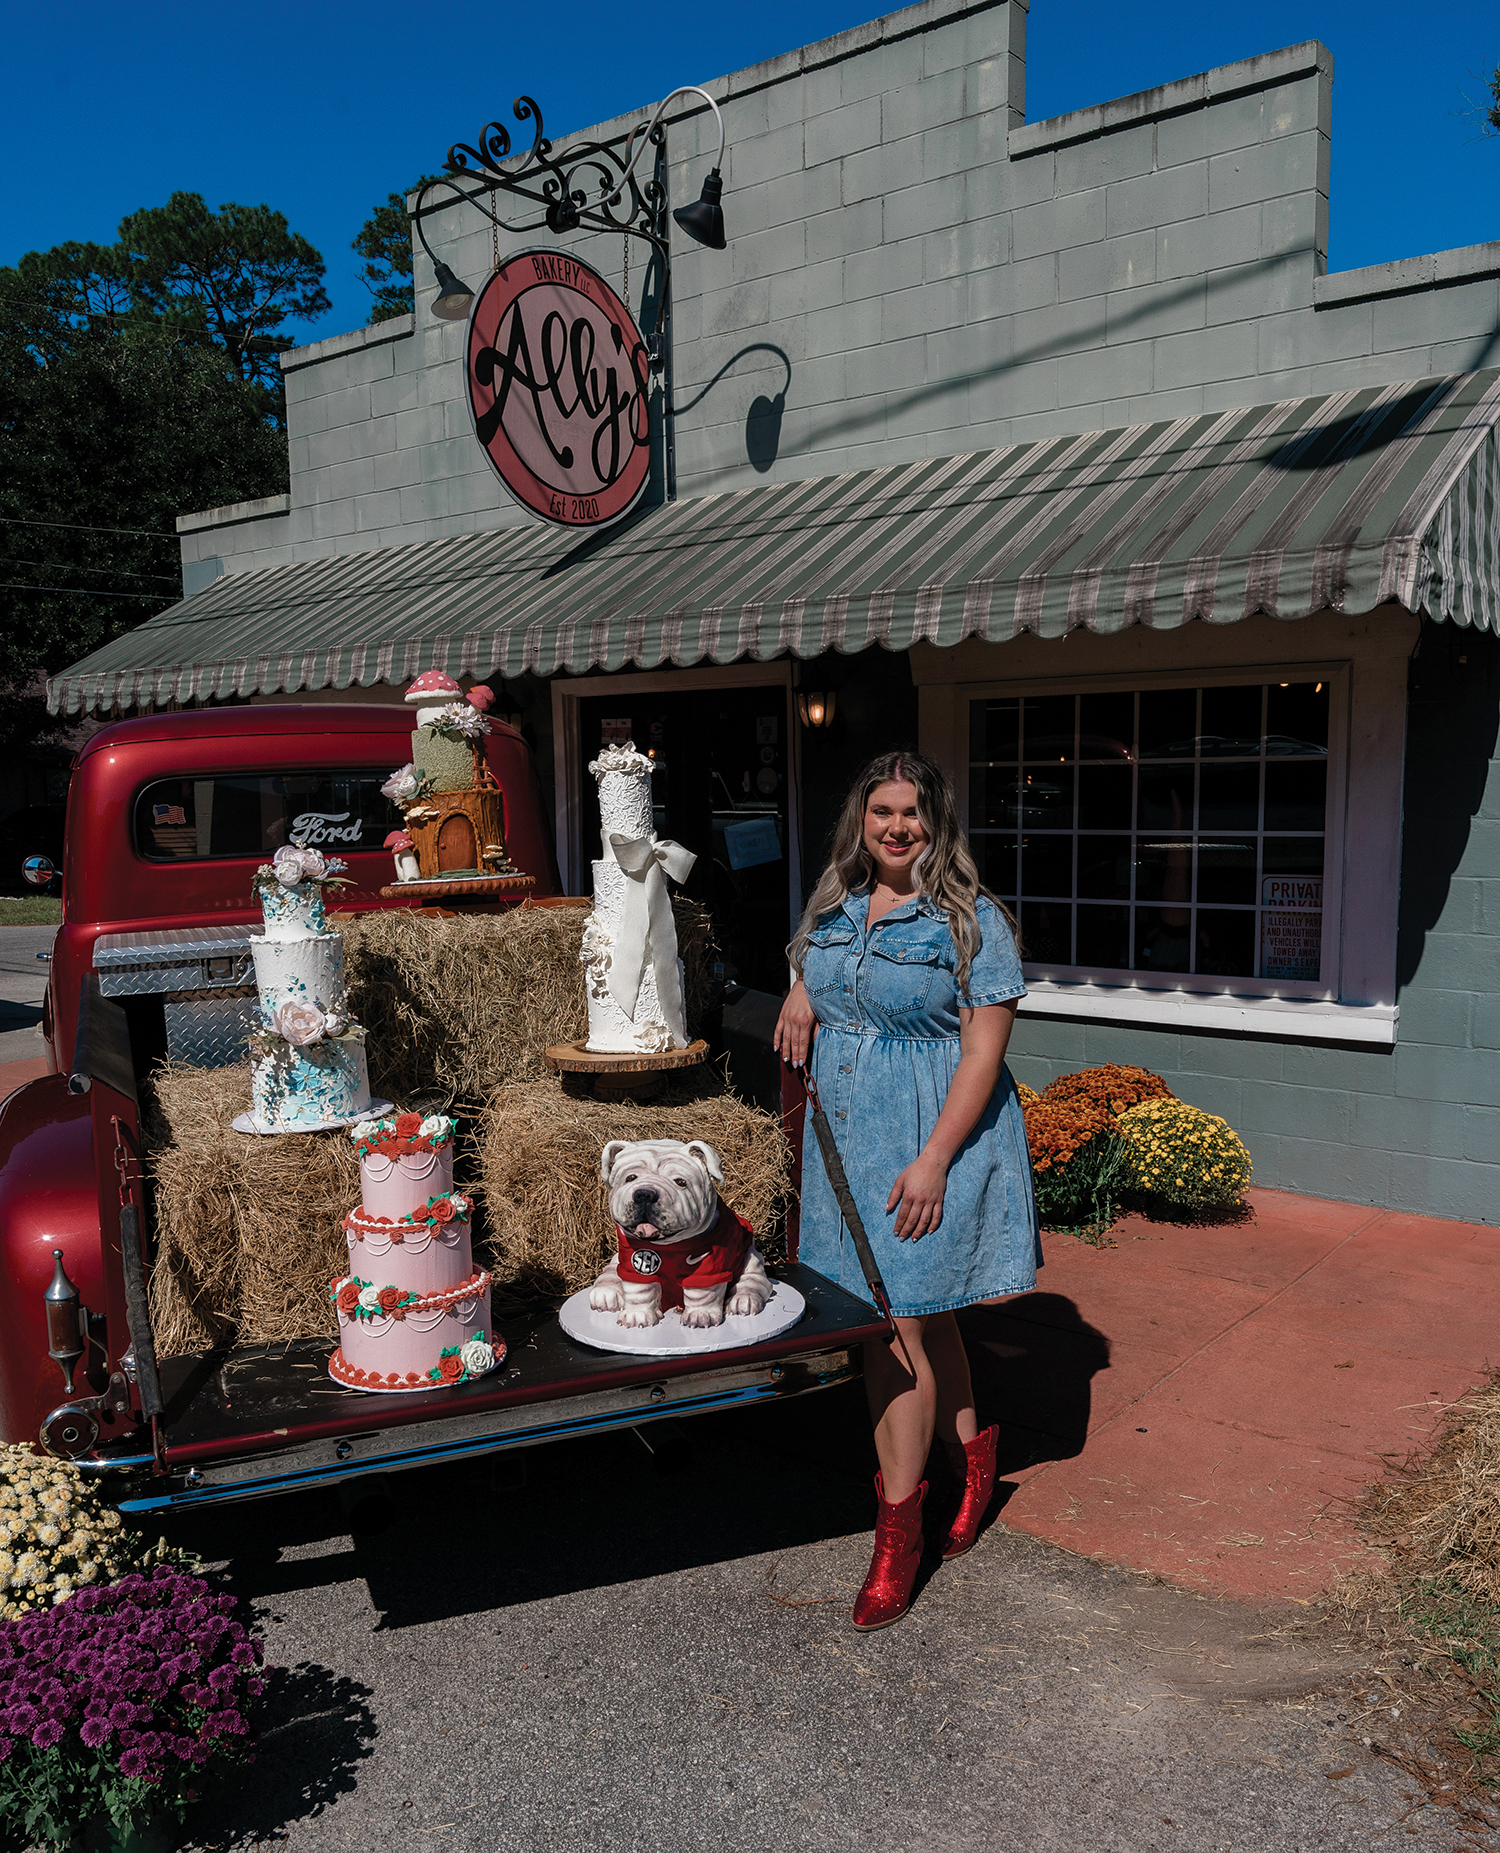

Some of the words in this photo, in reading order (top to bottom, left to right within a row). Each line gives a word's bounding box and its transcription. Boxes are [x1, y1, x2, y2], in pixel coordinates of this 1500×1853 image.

[531, 256, 580, 286] BAKERY
[580, 278, 591, 294] LLC
[475, 299, 650, 484] Ally's
[549, 493, 566, 518] Est
[571, 498, 600, 519] 2020
[289, 812, 363, 844] Ford
[739, 837, 765, 850] OPEN
[1271, 882, 1322, 899] PRIVAT
[1268, 917, 1303, 926] ILLEGALLY
[1266, 927, 1281, 936] AND
[1269, 937, 1301, 947] VEHICLES
[1303, 938, 1320, 948] WILL
[1273, 947, 1296, 956] TOWED
[1298, 948, 1317, 957] AWAY
[1268, 956, 1299, 967] OWNER'S
[633, 1251, 659, 1272] SEC
